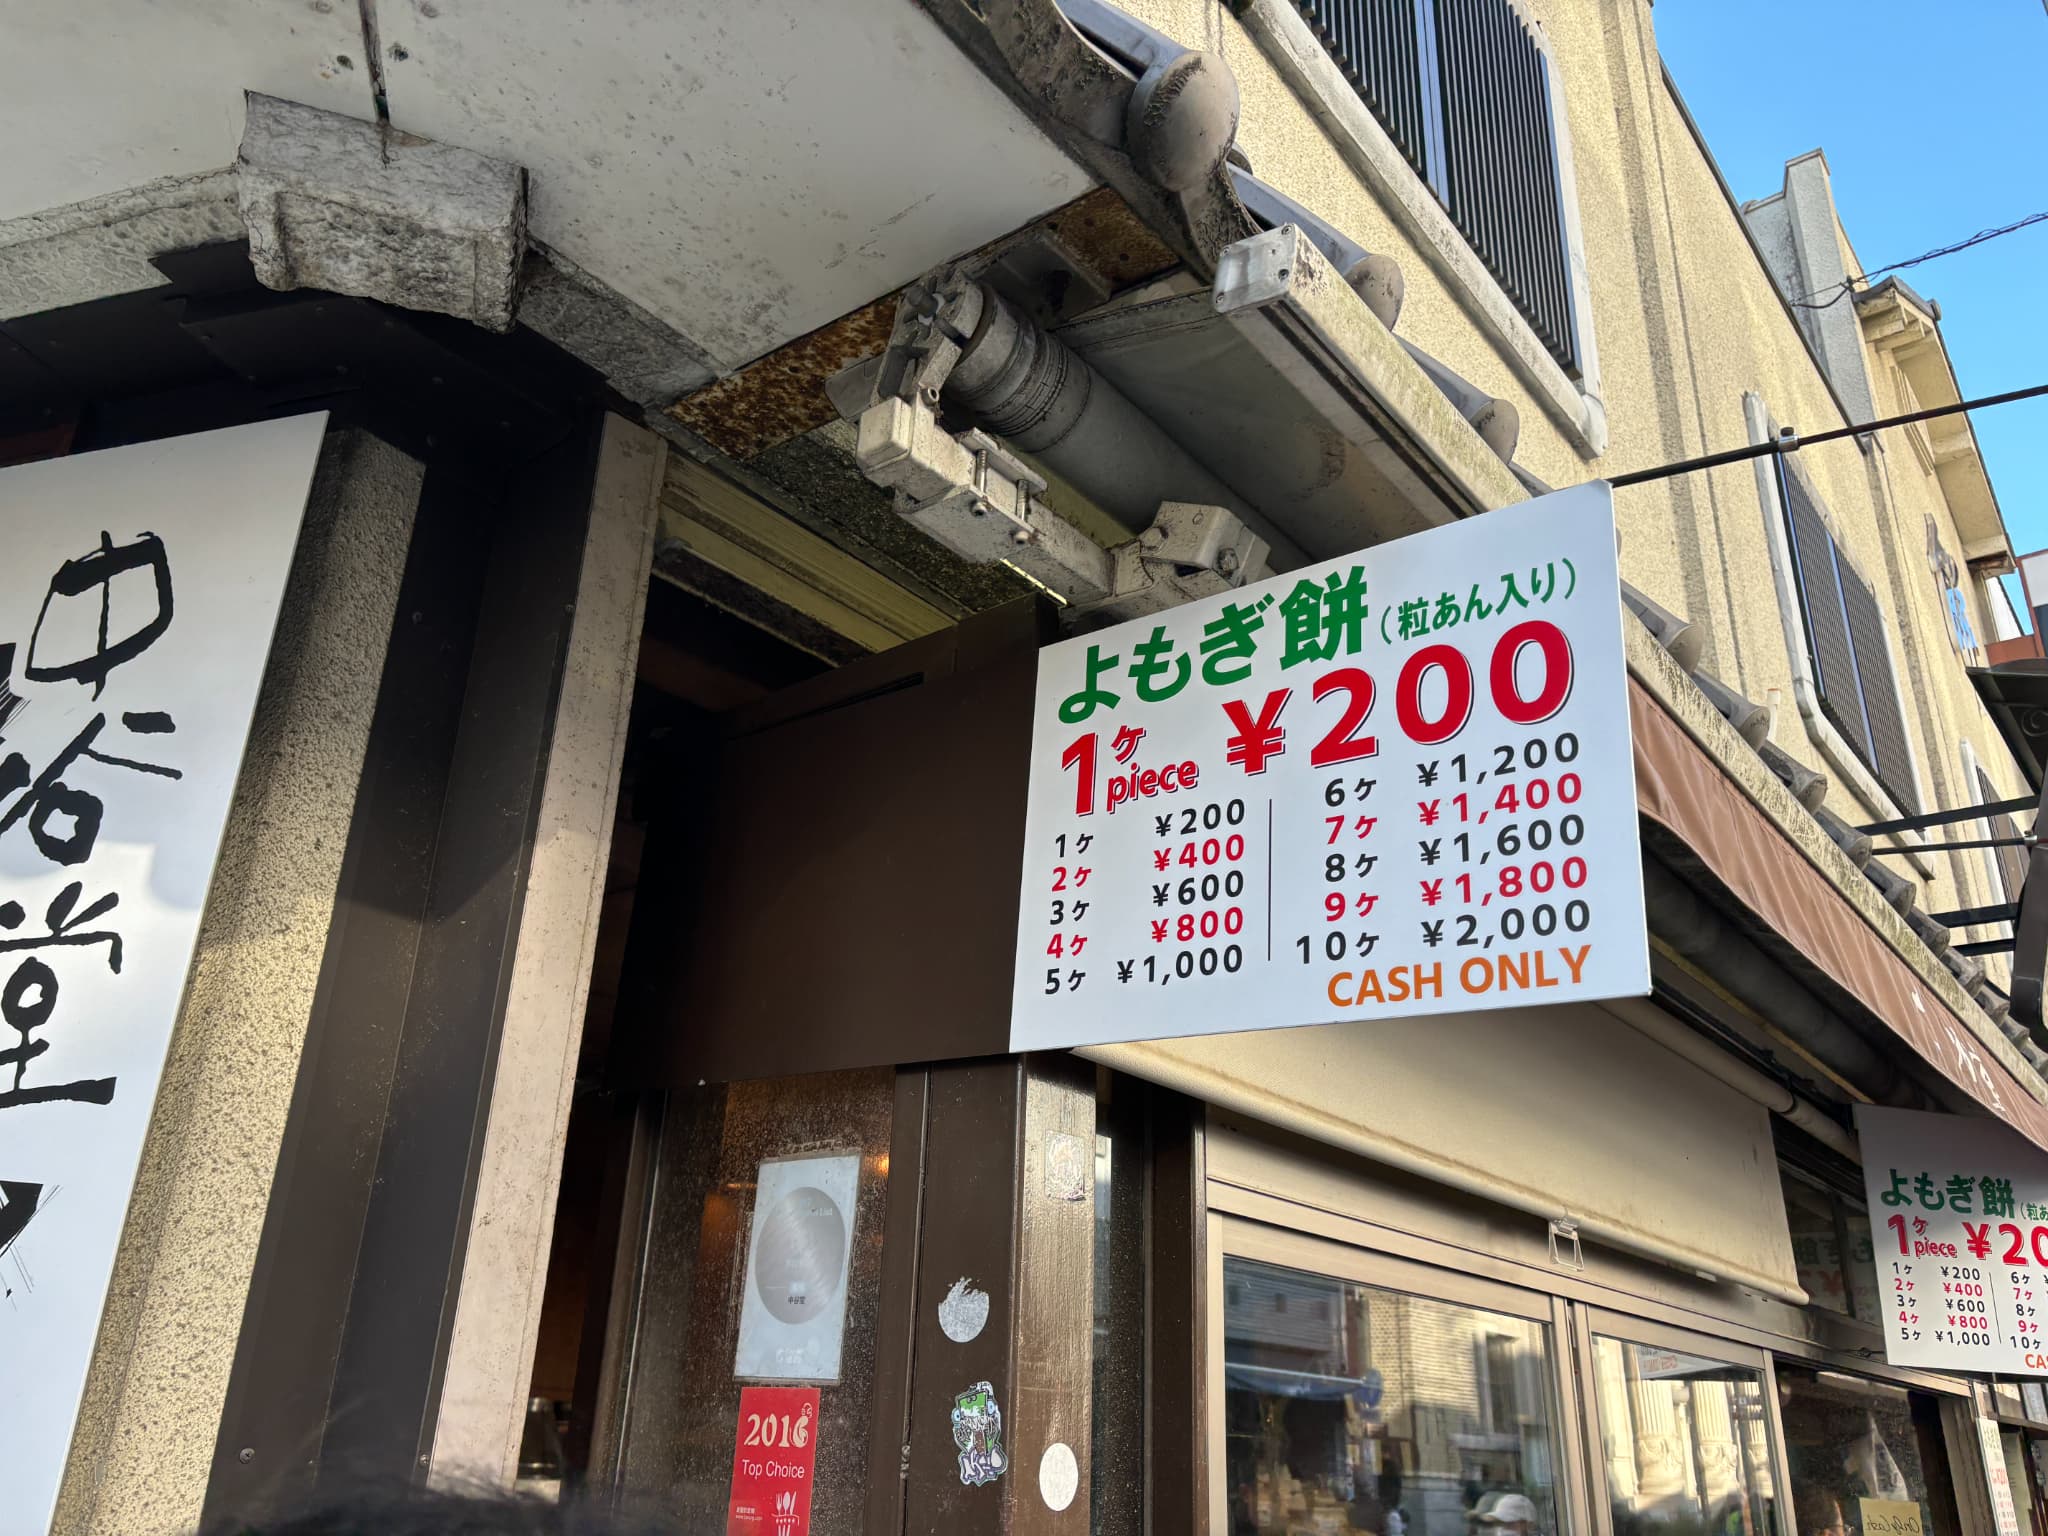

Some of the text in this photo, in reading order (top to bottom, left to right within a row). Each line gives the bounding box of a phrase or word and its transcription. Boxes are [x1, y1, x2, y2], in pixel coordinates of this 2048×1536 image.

[1058, 566, 1369, 724] よもぎ餅
[1107, 754, 1199, 816] piece
[1223, 619, 1574, 776] ¥200
[1417, 732, 1580, 791] ¥1,200
[1155, 799, 1245, 839] ¥200
[1418, 772, 1582, 828] ¥1,400
[1153, 833, 1245, 872] ¥400
[1419, 813, 1585, 868] ¥1,600
[1152, 869, 1244, 908] ¥600
[1419, 854, 1588, 908] ¥1,800
[1150, 906, 1243, 945] ¥800
[1421, 898, 1591, 950] ¥2,000
[1117, 943, 1243, 987] ¥1,000
[1326, 944, 1592, 1008] CASH ONLY
[1881, 1168, 2015, 1219] よもぎ餅
[1914, 1236, 1957, 1259] piece
[1940, 1266, 1980, 1280] ¥200
[1943, 1282, 1983, 1297] ¥400
[1945, 1298, 1985, 1313] ¥600
[1948, 1314, 1988, 1329] ¥800
[1935, 1330, 1990, 1346] ¥1,000
[742, 1459, 805, 1480] Top Choice
